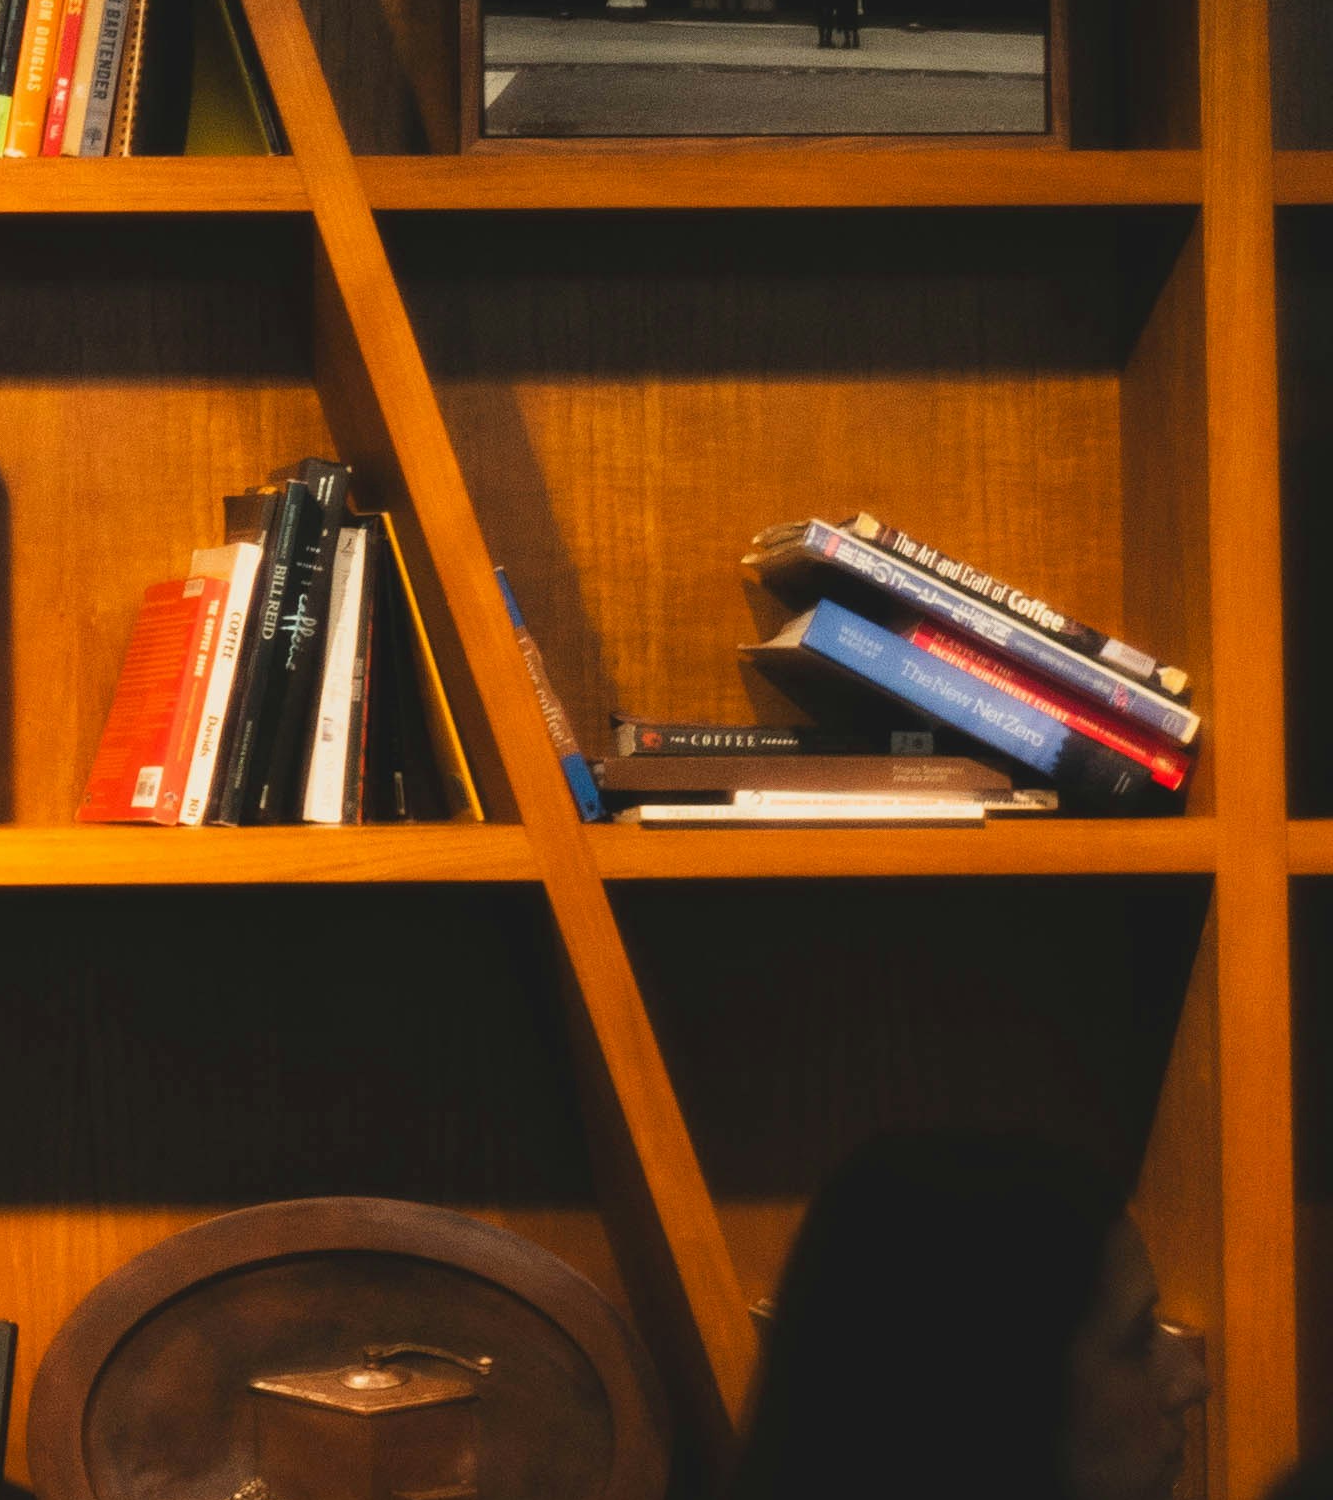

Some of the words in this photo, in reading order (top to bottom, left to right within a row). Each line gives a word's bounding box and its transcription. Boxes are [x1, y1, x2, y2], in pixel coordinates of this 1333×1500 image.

[24, 25, 51, 93] DOUGLAS
[88, 8, 124, 100] BARTENDER
[268, 563, 287, 599] BILL
[890, 530, 919, 558] The
[914, 544, 938, 568] Art
[934, 553, 964, 582] and
[958, 565, 994, 596] Craft
[988, 580, 1010, 605] of
[1004, 587, 1068, 634] Coffee
[207, 598, 219, 616] THE
[259, 599, 280, 640] REID
[272, 590, 321, 673] caffeine
[198, 617, 215, 652] COFFEE
[221, 610, 242, 660] COFFEE
[896, 657, 936, 689] The
[930, 675, 974, 710] New
[970, 697, 1008, 728] Net
[1001, 713, 1047, 749] Zero
[926, 642, 968, 671] PACIFIC
[965, 663, 1035, 705] NORTHWEST
[1031, 696, 1070, 724] COAST
[199, 714, 218, 758] Davids
[689, 733, 757, 748] COFFEE
